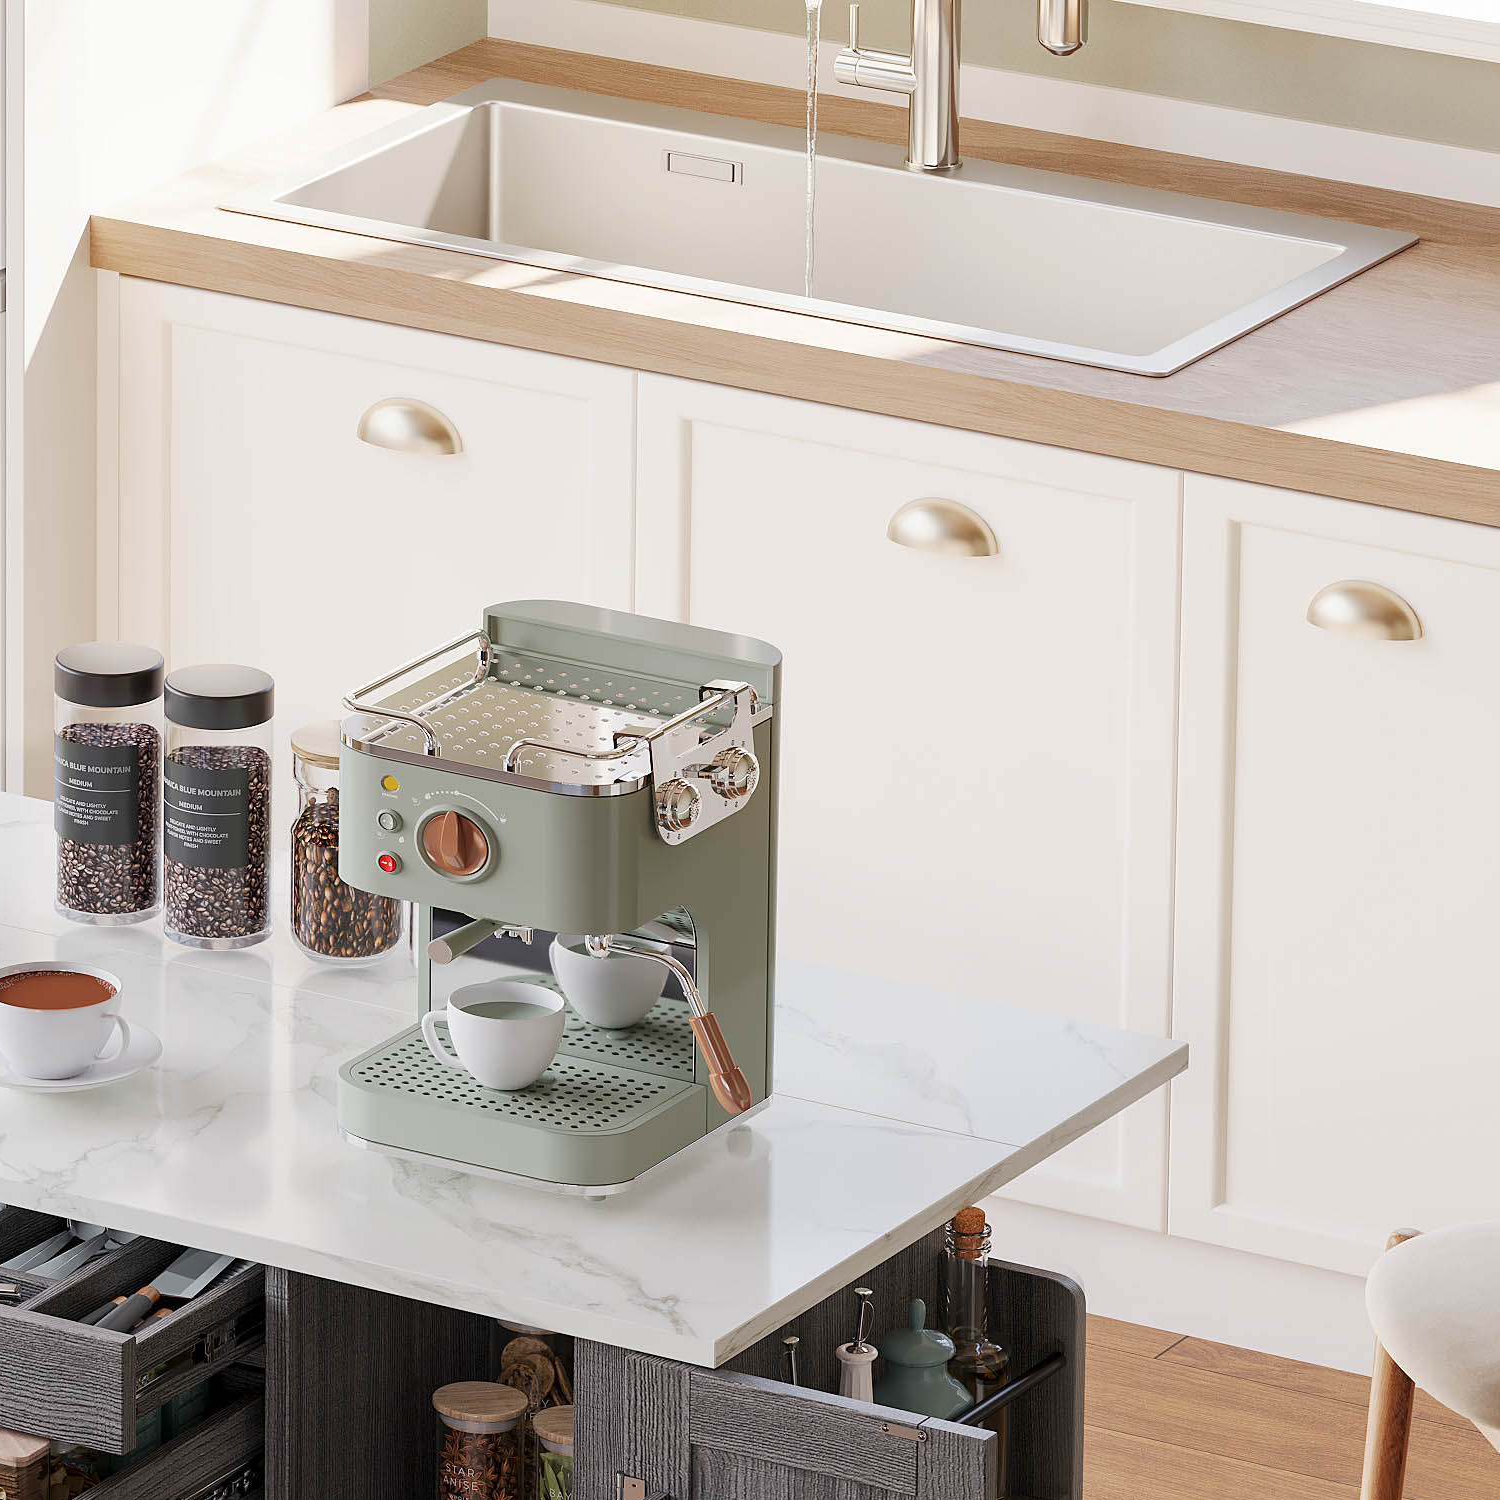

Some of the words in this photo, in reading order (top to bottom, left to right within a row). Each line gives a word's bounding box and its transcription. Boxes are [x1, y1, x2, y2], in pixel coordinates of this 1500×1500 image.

[70, 761, 86, 772] BLUE
[88, 765, 131, 774] MOUNTAIN
[69, 777, 92, 788] MEDIUM
[180, 785, 196, 795] BLUE
[198, 788, 242, 798] MOUNTAIN
[178, 800, 203, 812] MEDIUM
[445, 1462, 476, 1478] STAR
[443, 1474, 479, 1492] ANISE
